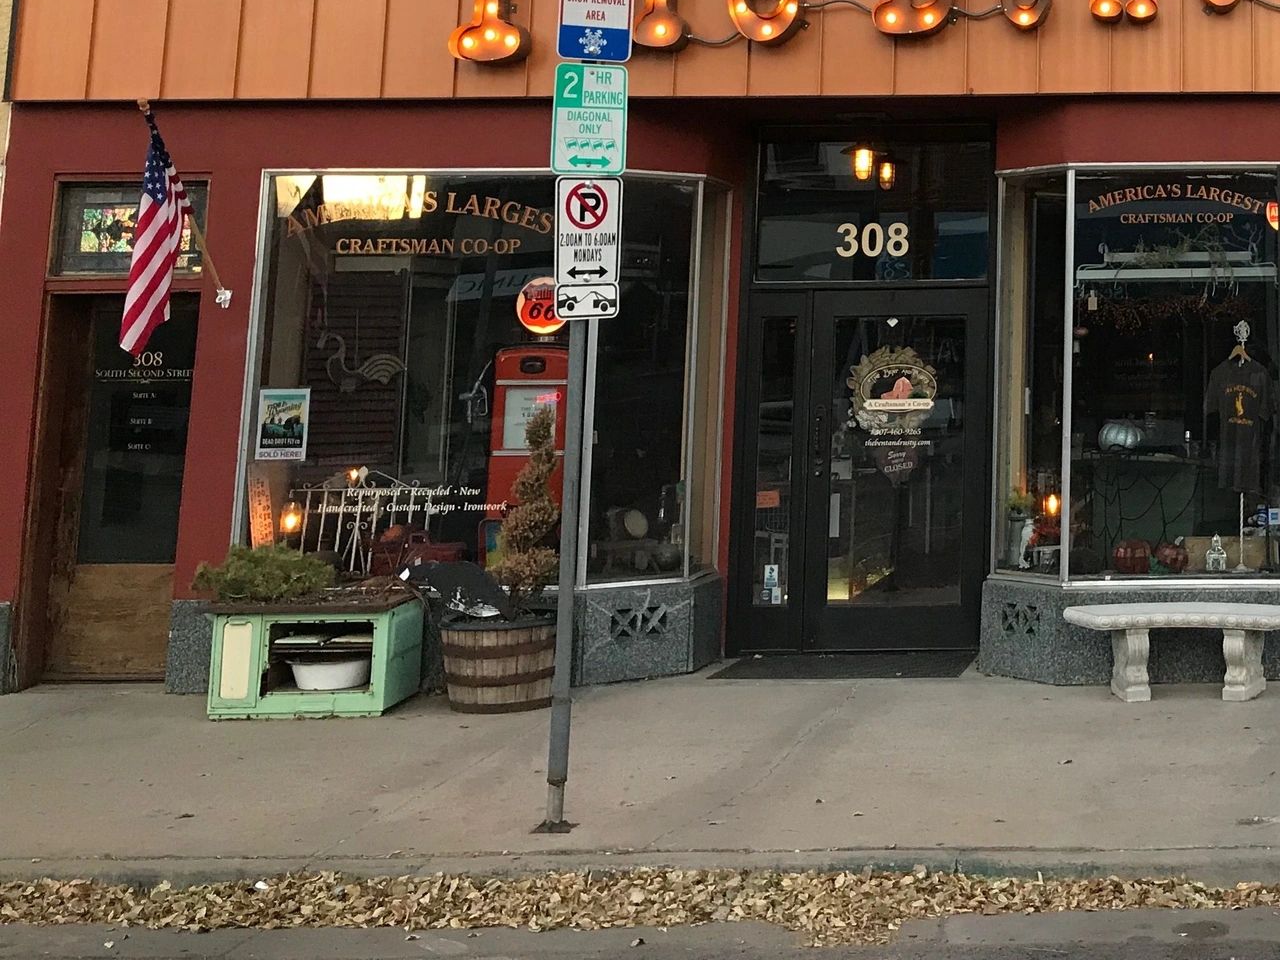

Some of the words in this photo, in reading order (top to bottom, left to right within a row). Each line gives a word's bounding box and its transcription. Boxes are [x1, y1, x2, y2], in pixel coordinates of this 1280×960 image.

[586, 10, 606, 21] AREA
[563, 71, 579, 98] 2
[596, 71, 613, 85] HR
[584, 90, 623, 105] PARKING
[567, 110, 613, 122] DIAGONAL
[579, 123, 602, 134] ONLY
[1087, 183, 1181, 214] AMERICA'S
[1185, 184, 1265, 215] LARGEST
[446, 192, 555, 235] LARGES
[1120, 213, 1193, 224] CRAFTSMAN
[1196, 212, 1234, 223] CO-OP
[336, 238, 455, 255] CRAFTSMAN
[460, 238, 521, 255] CO-OP
[584, 233, 592, 246] TO
[836, 222, 909, 258] 308
[573, 248, 602, 262] MONDAYS
[133, 351, 163, 367] 308
[884, 462, 913, 473] CLOSED
[346, 486, 401, 500] Repurposed
[410, 486, 451, 500] Recycled
[459, 486, 481, 496] New
[317, 502, 376, 516] Handcrafted
[386, 502, 421, 512] Custom
[424, 502, 456, 515] Design
[463, 502, 507, 512] Ironwork
